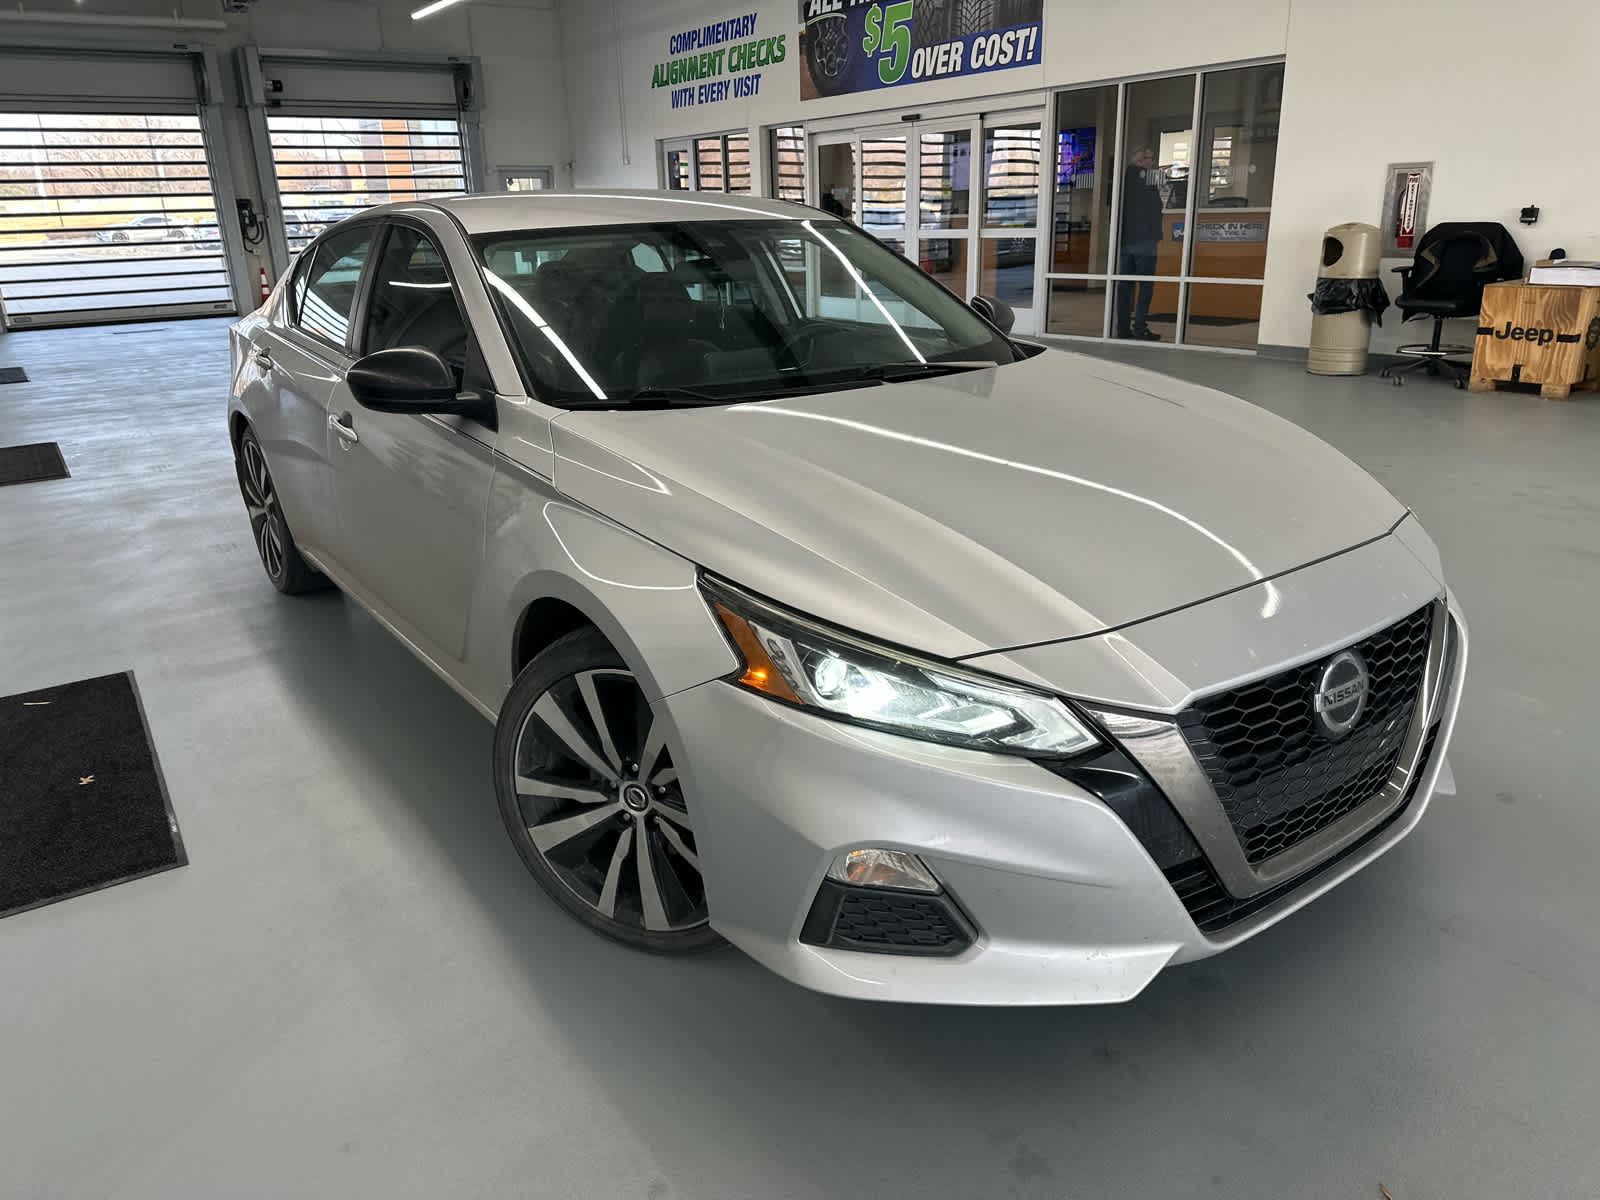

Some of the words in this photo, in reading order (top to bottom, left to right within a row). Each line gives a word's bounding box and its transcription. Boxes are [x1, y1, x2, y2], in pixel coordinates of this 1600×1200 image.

[670, 13, 757, 54] COMPLIMENTARY
[863, 1, 914, 84] $5
[911, 41, 962, 78] OVER
[970, 26, 1038, 69] COST!
[651, 48, 726, 88] ALIGNMENT
[728, 34, 785, 72] CHECKS
[671, 87, 695, 109] WITH
[698, 80, 730, 104] EVERY
[734, 74, 761, 98] VISIT
[1495, 321, 1554, 346] Jeep
[1323, 680, 1364, 707] NISSAN
